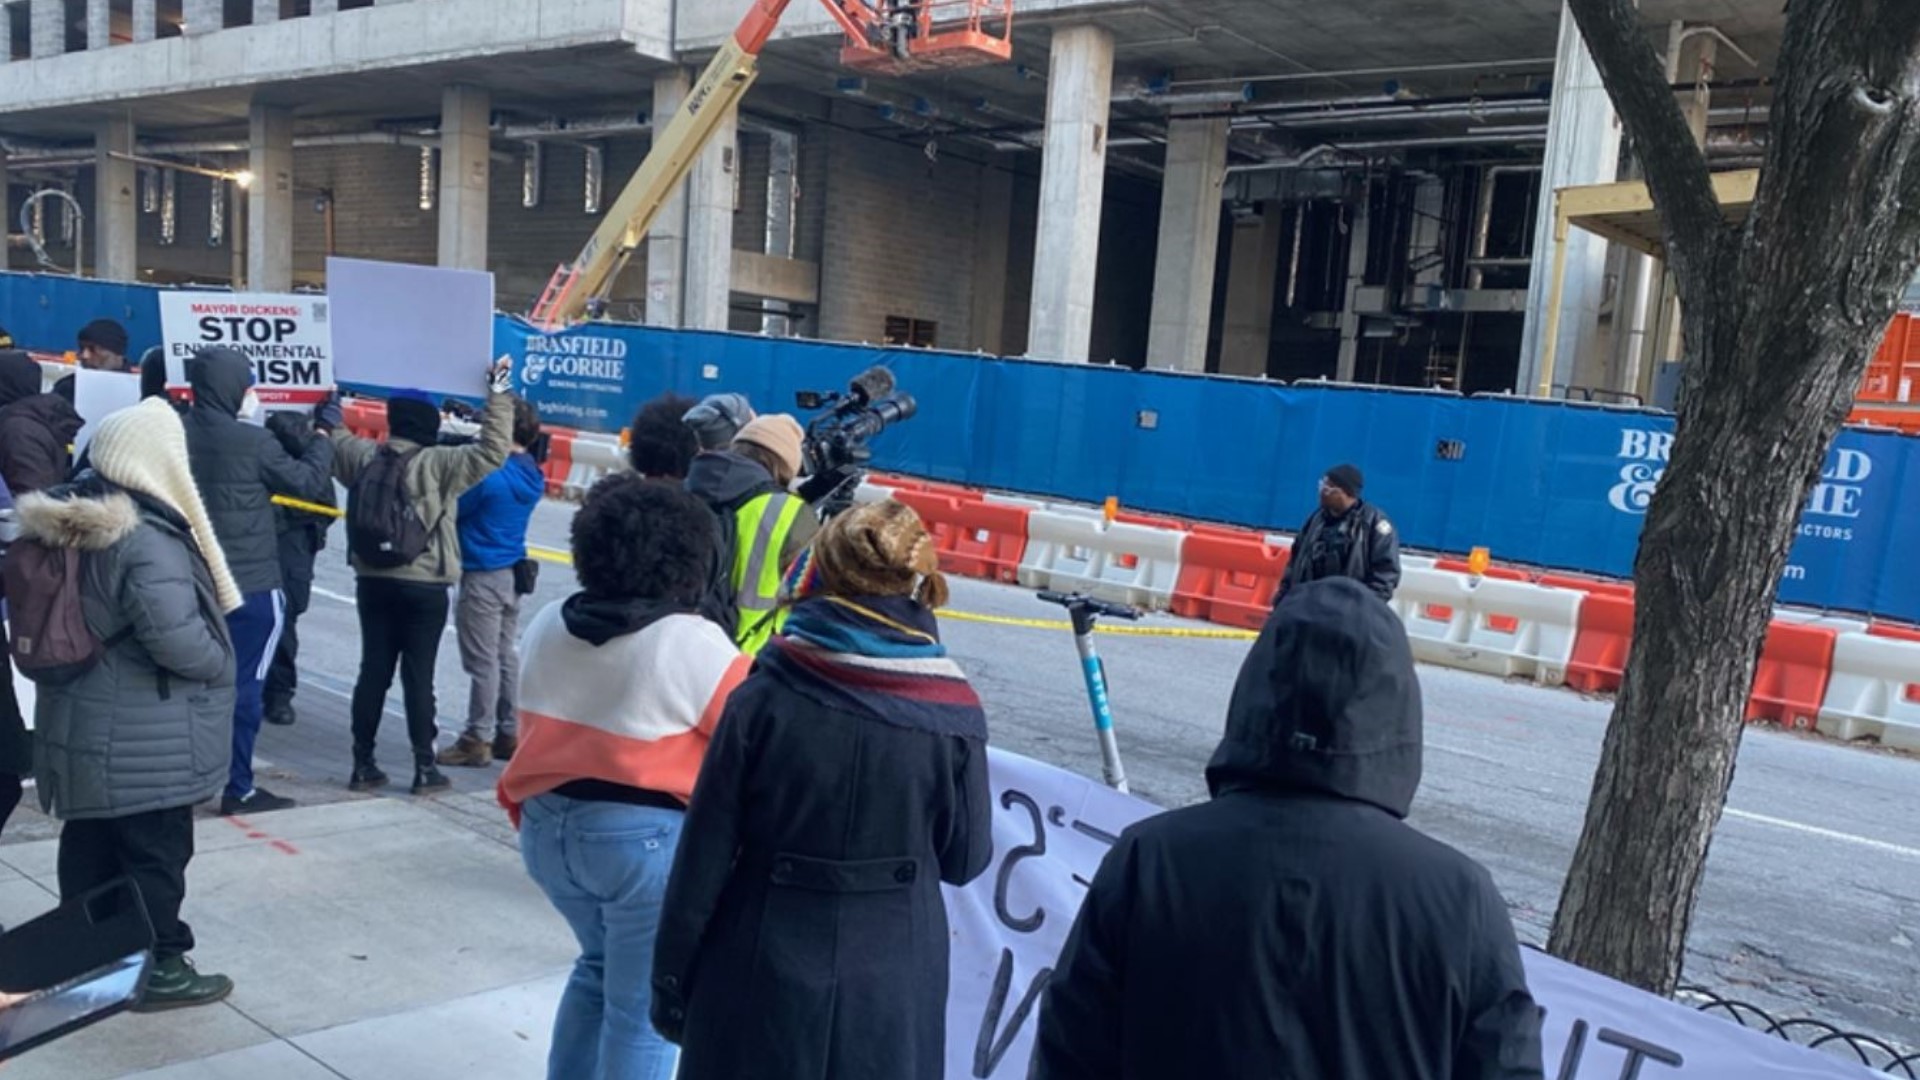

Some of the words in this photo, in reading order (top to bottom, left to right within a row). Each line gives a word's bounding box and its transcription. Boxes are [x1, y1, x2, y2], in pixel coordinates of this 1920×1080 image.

[191, 303, 238, 315] MAYOR
[240, 304, 301, 316] DICKENS:
[199, 316, 297, 343] STOP
[183, 360, 321, 385] ISM
[521, 354, 546, 385] &
[548, 355, 625, 381] GORRIE
